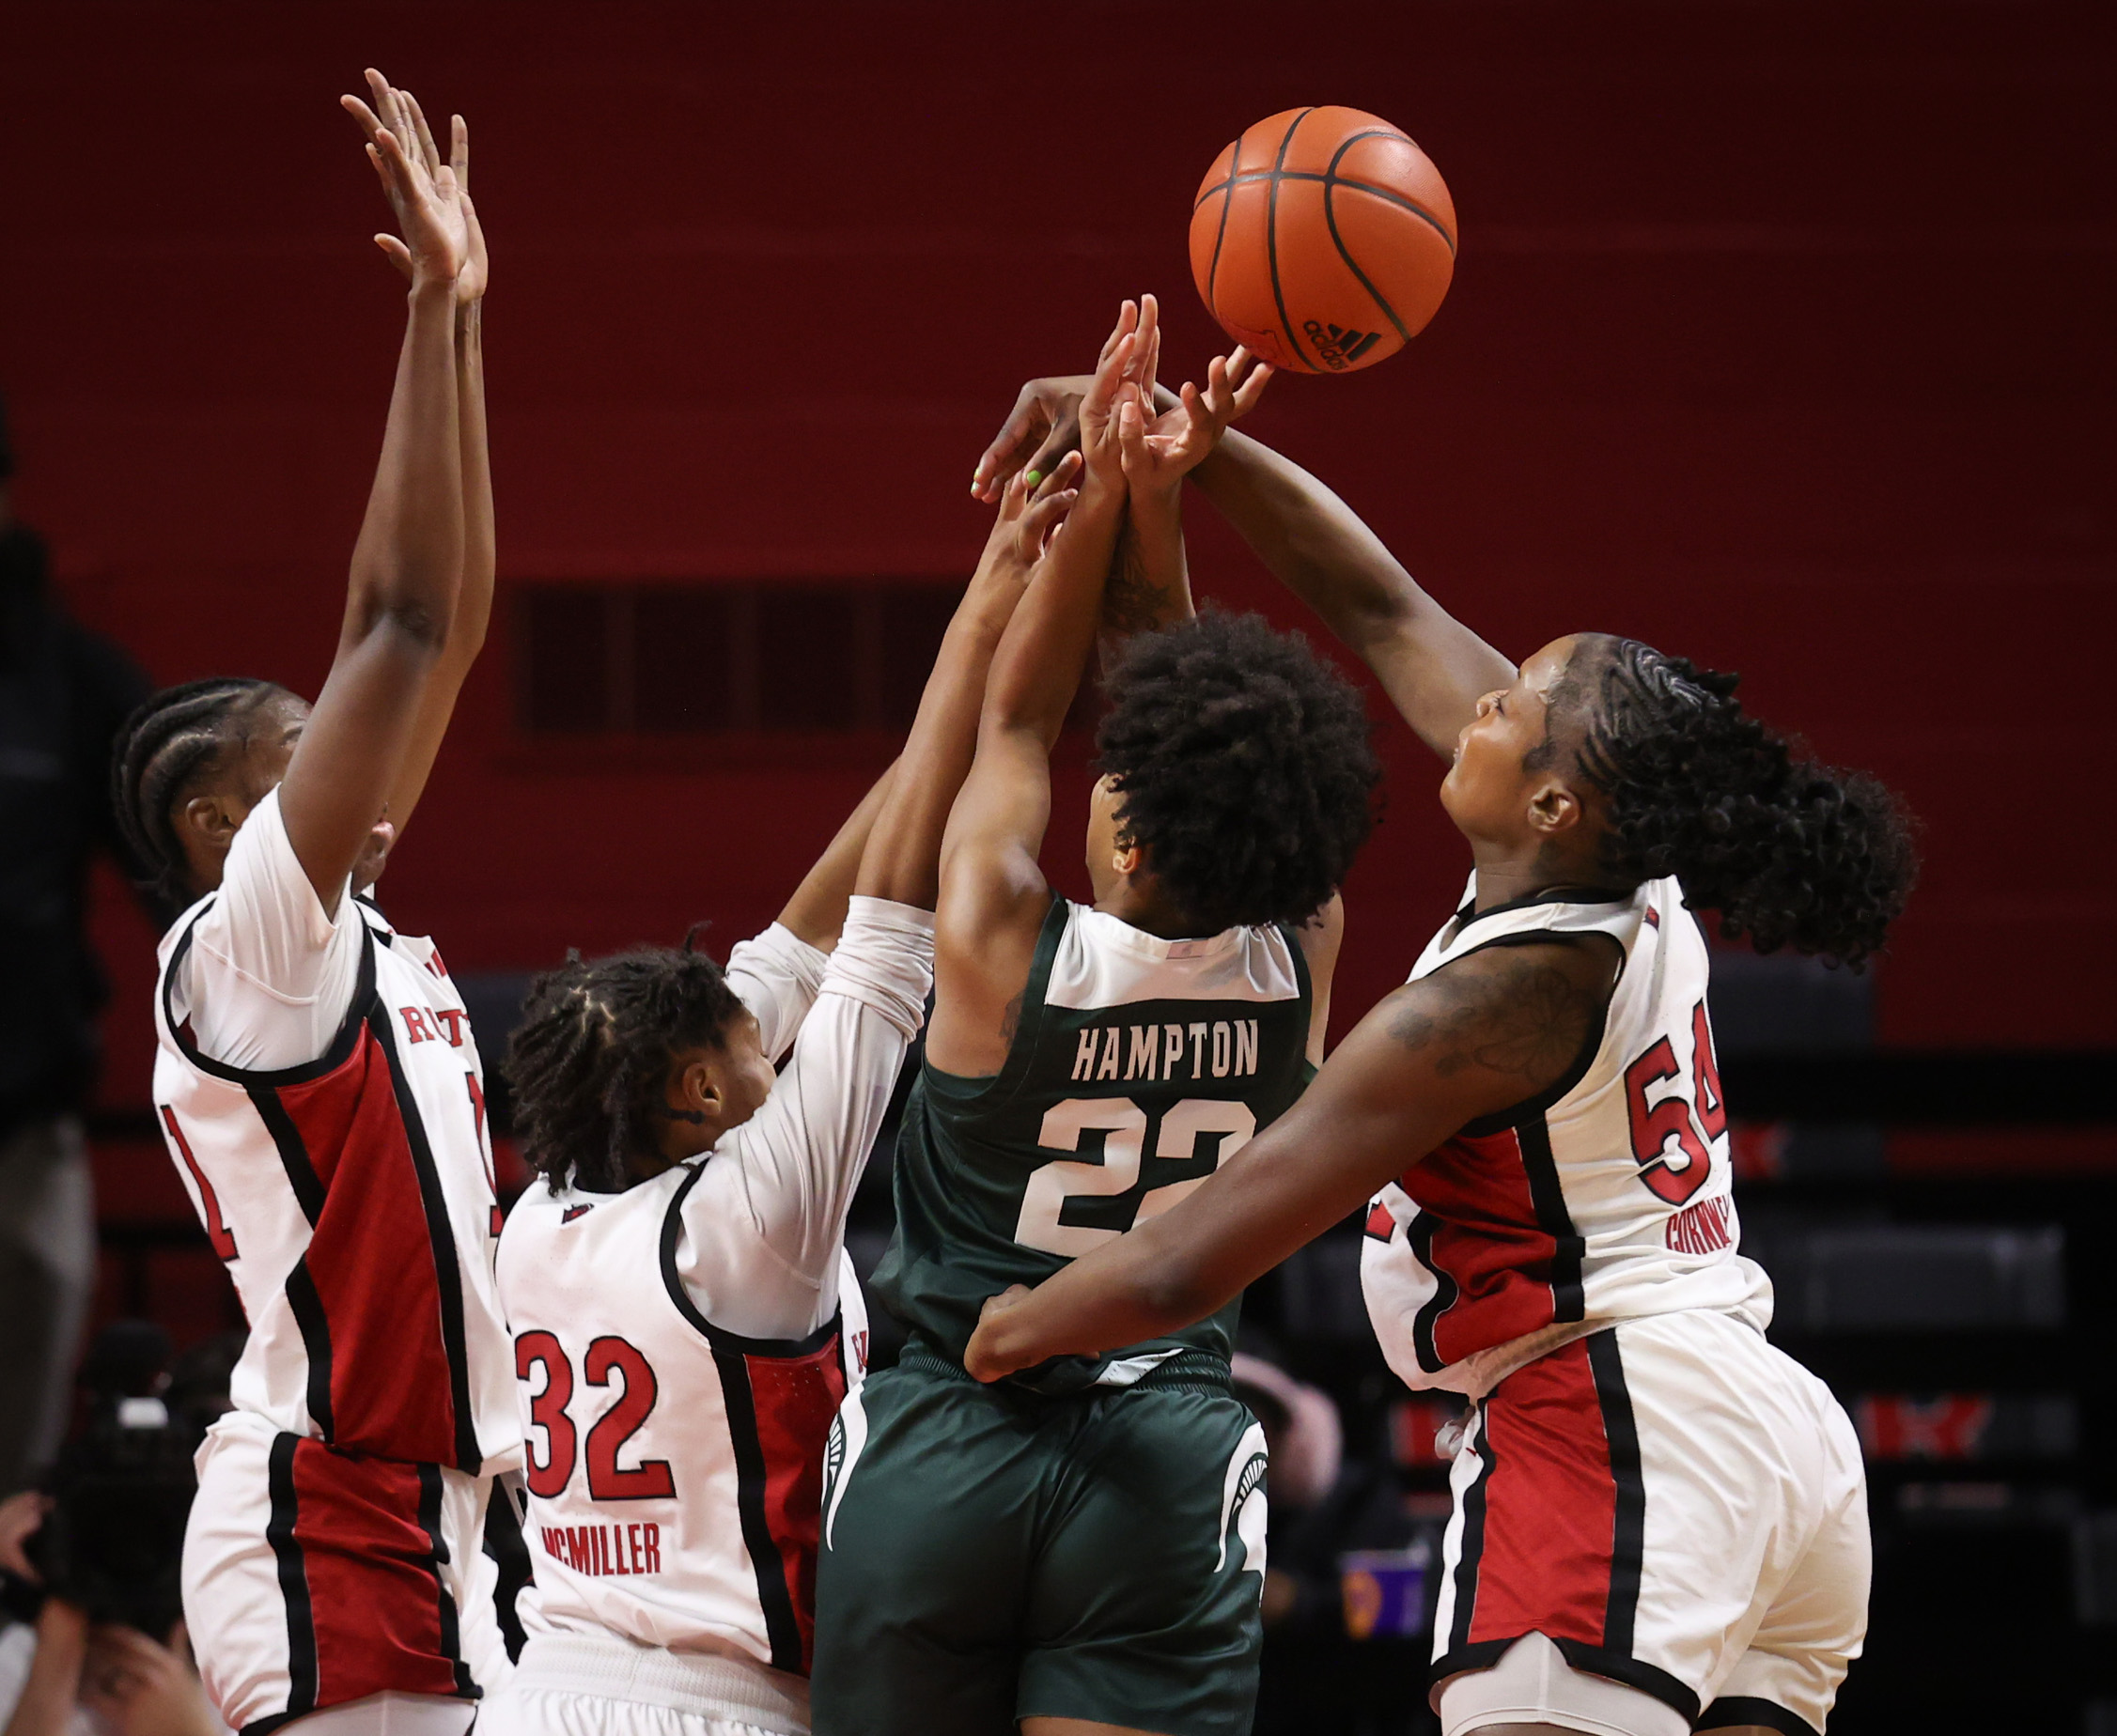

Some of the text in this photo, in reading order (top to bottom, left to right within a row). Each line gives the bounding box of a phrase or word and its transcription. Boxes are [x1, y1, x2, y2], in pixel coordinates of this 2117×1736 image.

[1303, 320, 1348, 370] adidas
[1070, 1018, 1259, 1081] HAMPTON
[1624, 998, 1727, 1206] 54
[1014, 1096, 1257, 1259] 22
[514, 1329, 677, 1501] 32
[541, 1522, 661, 1576] MCMILLER
